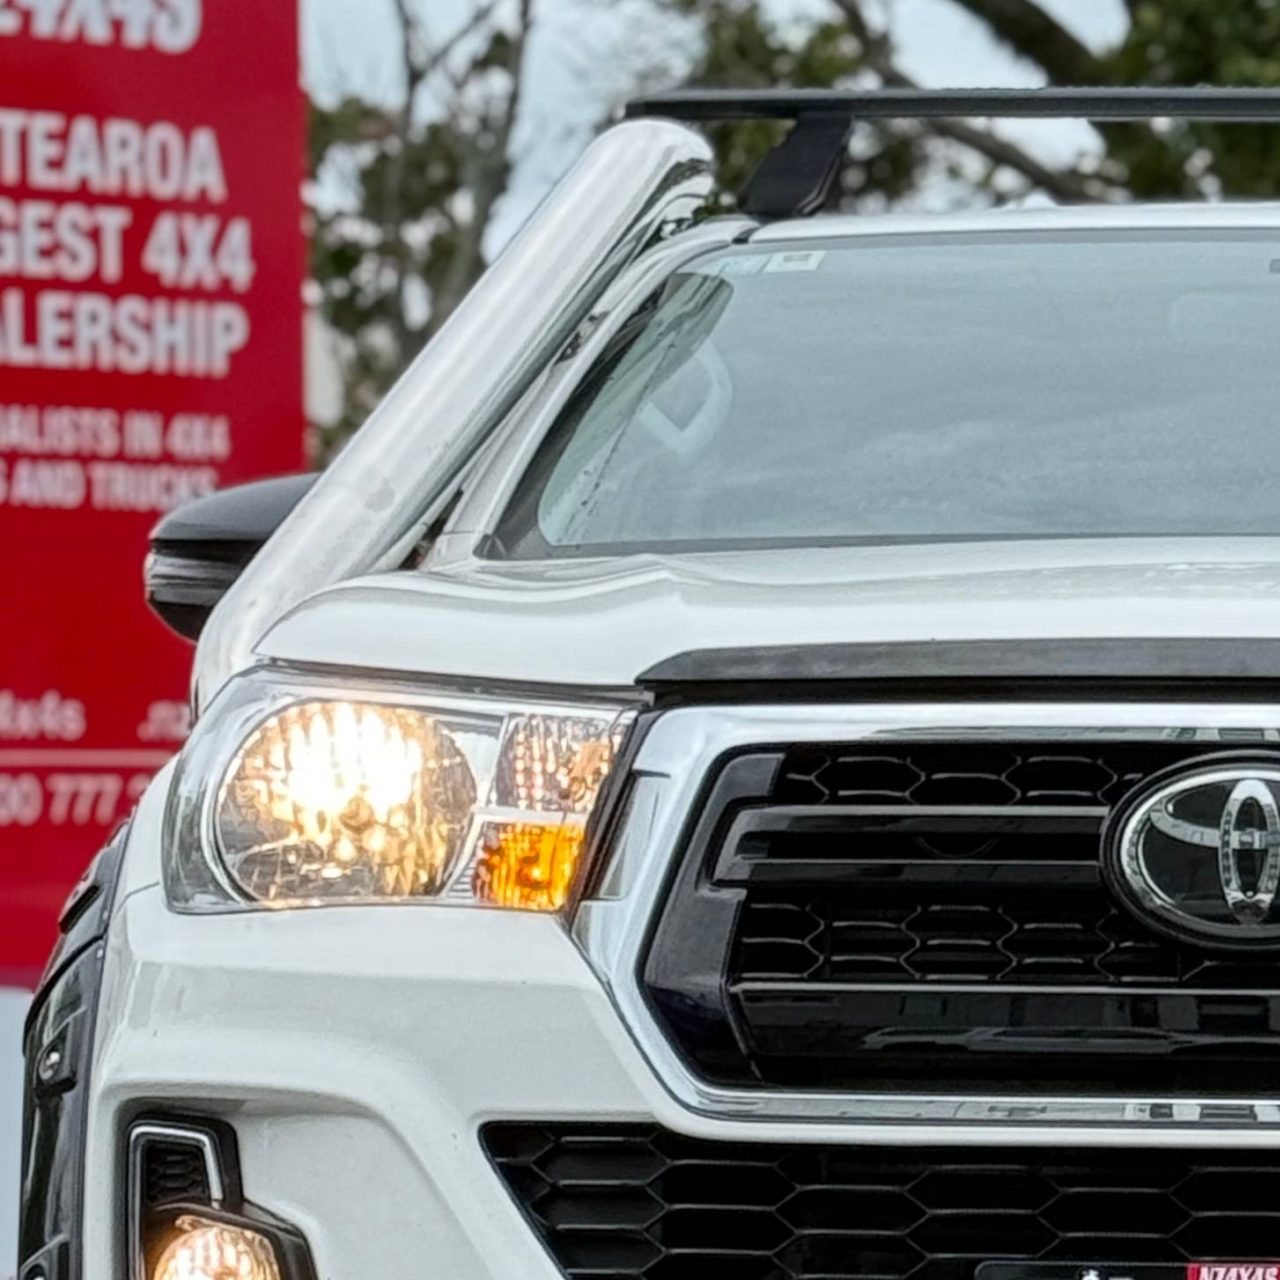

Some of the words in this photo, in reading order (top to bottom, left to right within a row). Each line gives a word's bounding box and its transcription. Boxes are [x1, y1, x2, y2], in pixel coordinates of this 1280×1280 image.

[140, 210, 256, 293] 4X4
[124, 409, 164, 460] IN
[9, 457, 86, 510] AND
[45, 772, 124, 827] 777
